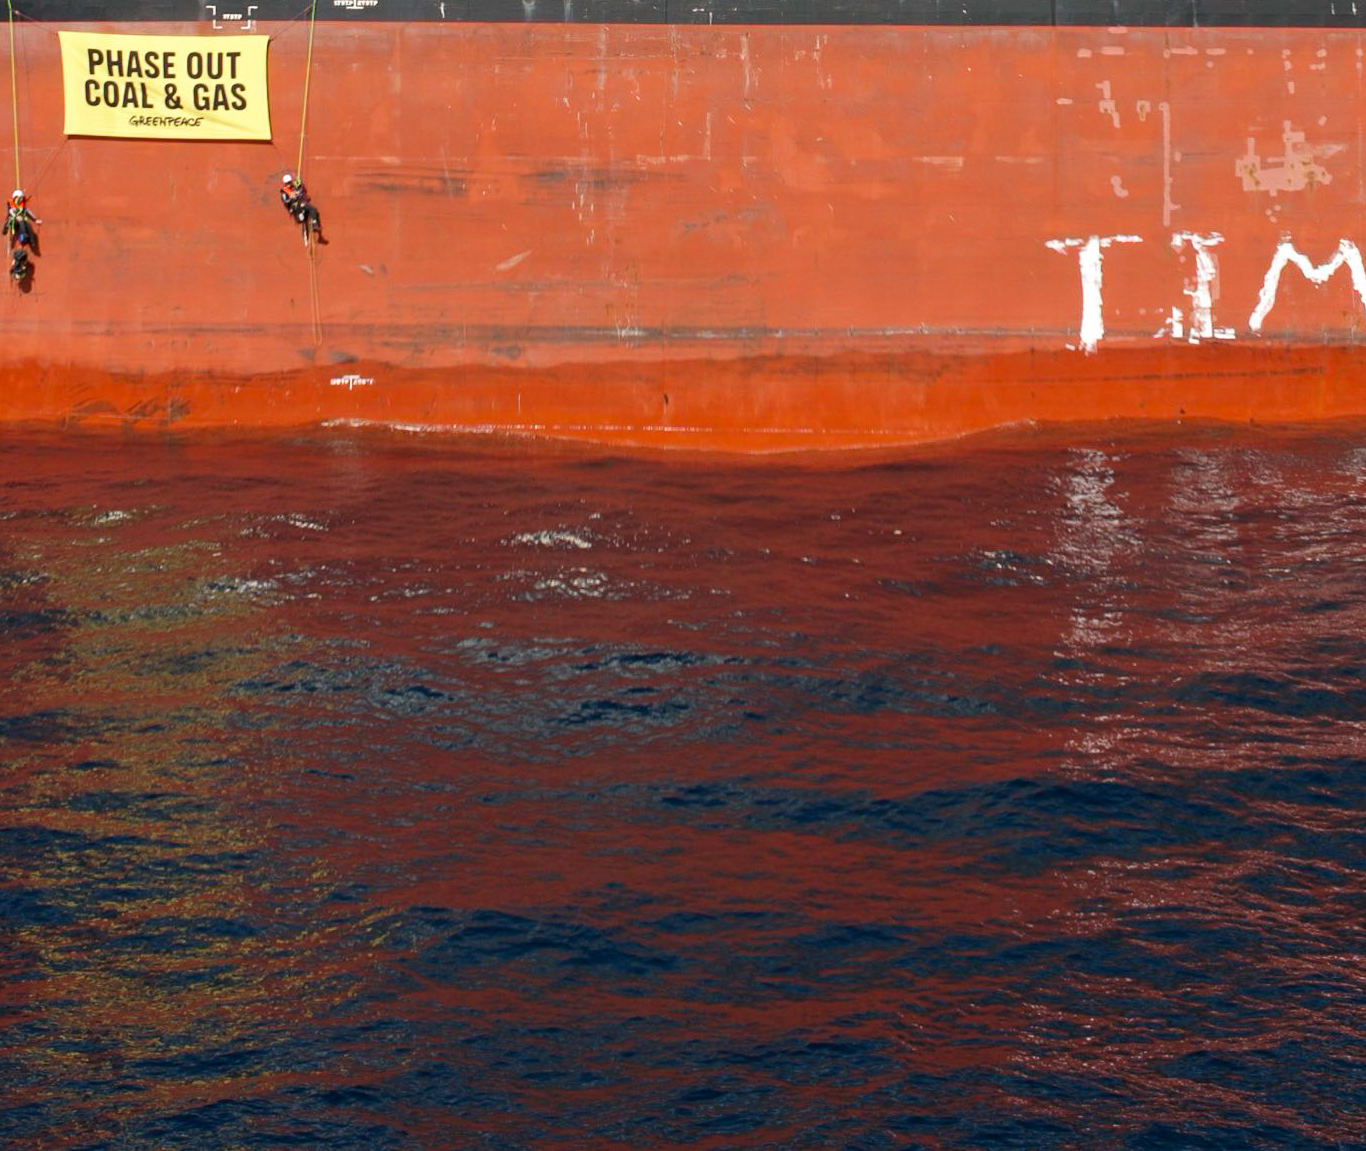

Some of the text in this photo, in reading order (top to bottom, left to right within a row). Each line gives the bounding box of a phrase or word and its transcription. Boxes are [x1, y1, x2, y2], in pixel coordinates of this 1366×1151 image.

[88, 48, 241, 80] PHASE OUT
[85, 79, 247, 111] COAL & GAS
[129, 115, 205, 127] GREENPEACE
